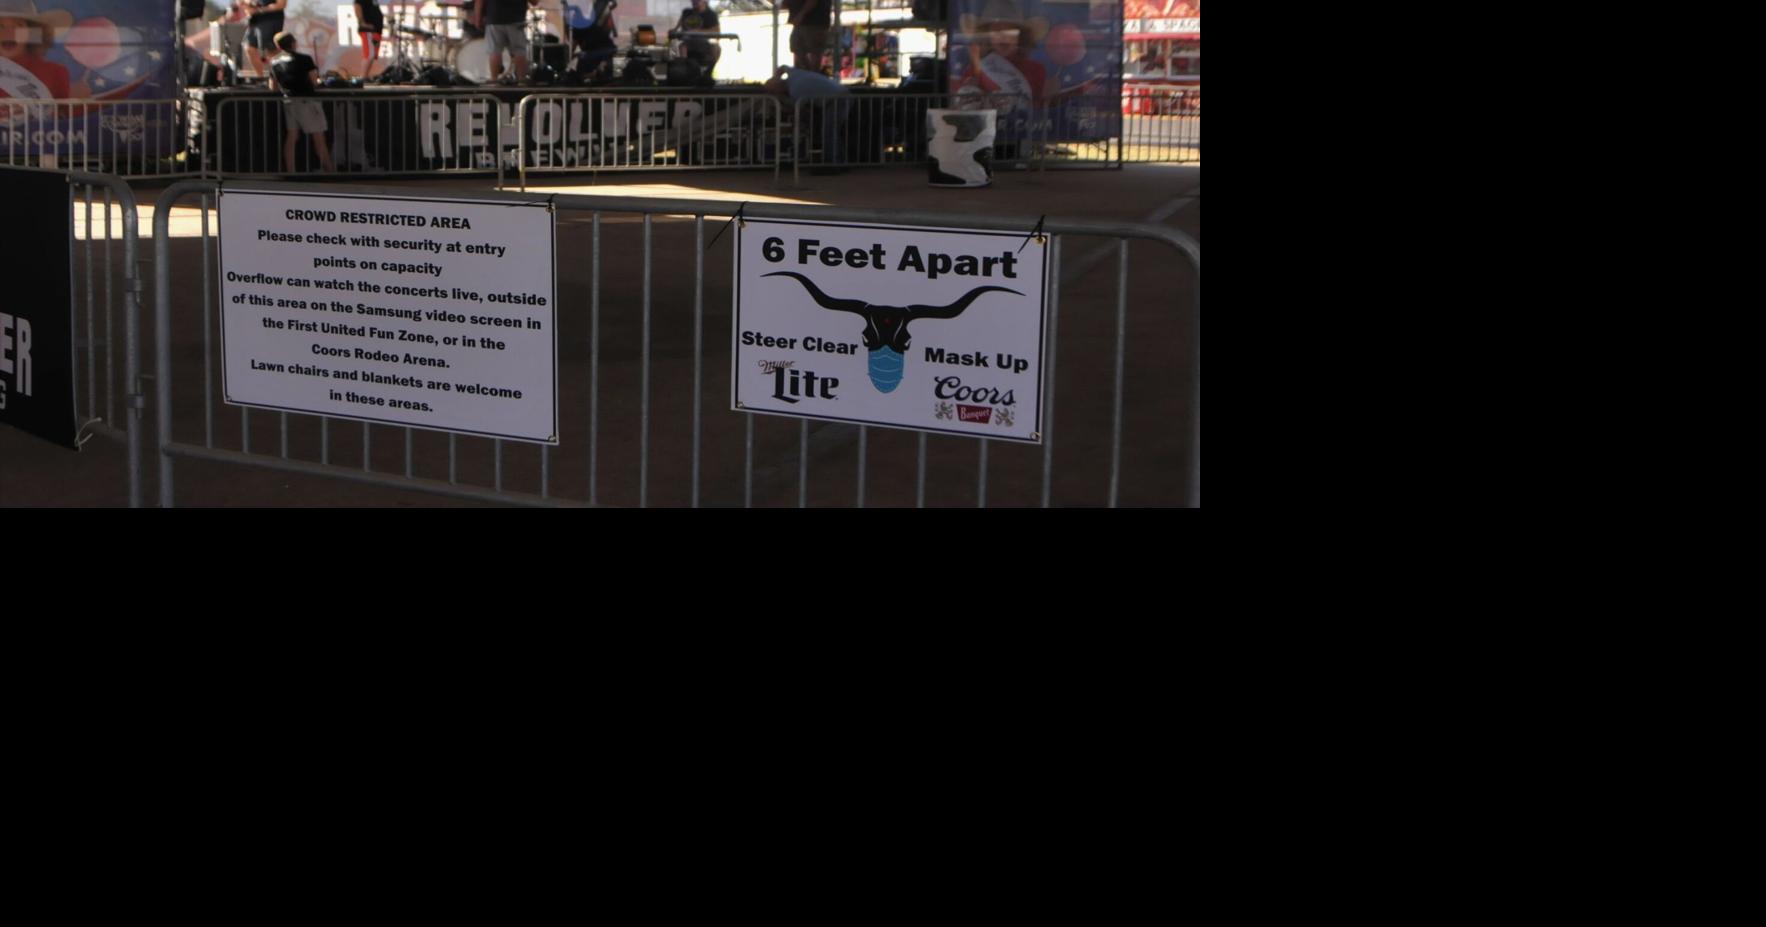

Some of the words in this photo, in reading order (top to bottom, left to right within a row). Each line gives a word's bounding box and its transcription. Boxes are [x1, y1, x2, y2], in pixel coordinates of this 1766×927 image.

[285, 209, 336, 223] CROWD
[340, 213, 426, 227] RESTRICTED
[430, 217, 471, 229] AREA
[258, 230, 303, 243] Please
[306, 233, 347, 245] check
[351, 236, 380, 247] with
[383, 238, 442, 253] security
[446, 242, 461, 252] at
[465, 244, 506, 257] entry
[313, 256, 356, 271] points
[360, 260, 377, 270] on
[381, 261, 442, 276] capacity
[762, 237, 785, 263] 6
[798, 239, 886, 270] Feet
[897, 245, 1017, 279] Apart
[227, 272, 283, 286] Overflow
[286, 277, 310, 288] can
[314, 278, 354, 291] watch
[358, 281, 381, 293] the
[384, 284, 448, 298] concerts
[452, 288, 483, 303] live,
[487, 292, 547, 305] outside
[232, 293, 246, 304] of
[249, 294, 274, 306] this
[277, 298, 307, 309] area
[310, 301, 328, 311] on
[331, 301, 353, 313] the
[356, 304, 422, 321] Samsung
[425, 309, 466, 323] video
[469, 315, 522, 328] screen
[527, 317, 541, 330] in
[263, 318, 284, 329] the
[287, 319, 318, 332] First
[321, 322, 366, 337] United
[369, 327, 394, 340] Fun
[398, 330, 439, 346] Zone,
[443, 336, 458, 345] or
[462, 336, 476, 347] in
[480, 337, 505, 350] the
[742, 331, 797, 349] Steer
[802, 337, 858, 355] Clear
[311, 344, 351, 358] Coors
[354, 349, 399, 363] Rodeo
[403, 355, 450, 368] Arena.
[924, 347, 989, 368] Mask
[996, 353, 1029, 374] Up
[251, 359, 285, 372] Lawn
[288, 364, 330, 378] chairs
[333, 368, 358, 381] and
[362, 371, 423, 388] blankets
[427, 381, 451, 391] are
[455, 384, 522, 399] welcome
[771, 366, 839, 404] Lite
[934, 376, 1015, 406] Coors
[329, 390, 342, 400] in
[346, 391, 385, 406] these
[389, 399, 433, 412] areas.
[960, 407, 991, 420] Banquet
